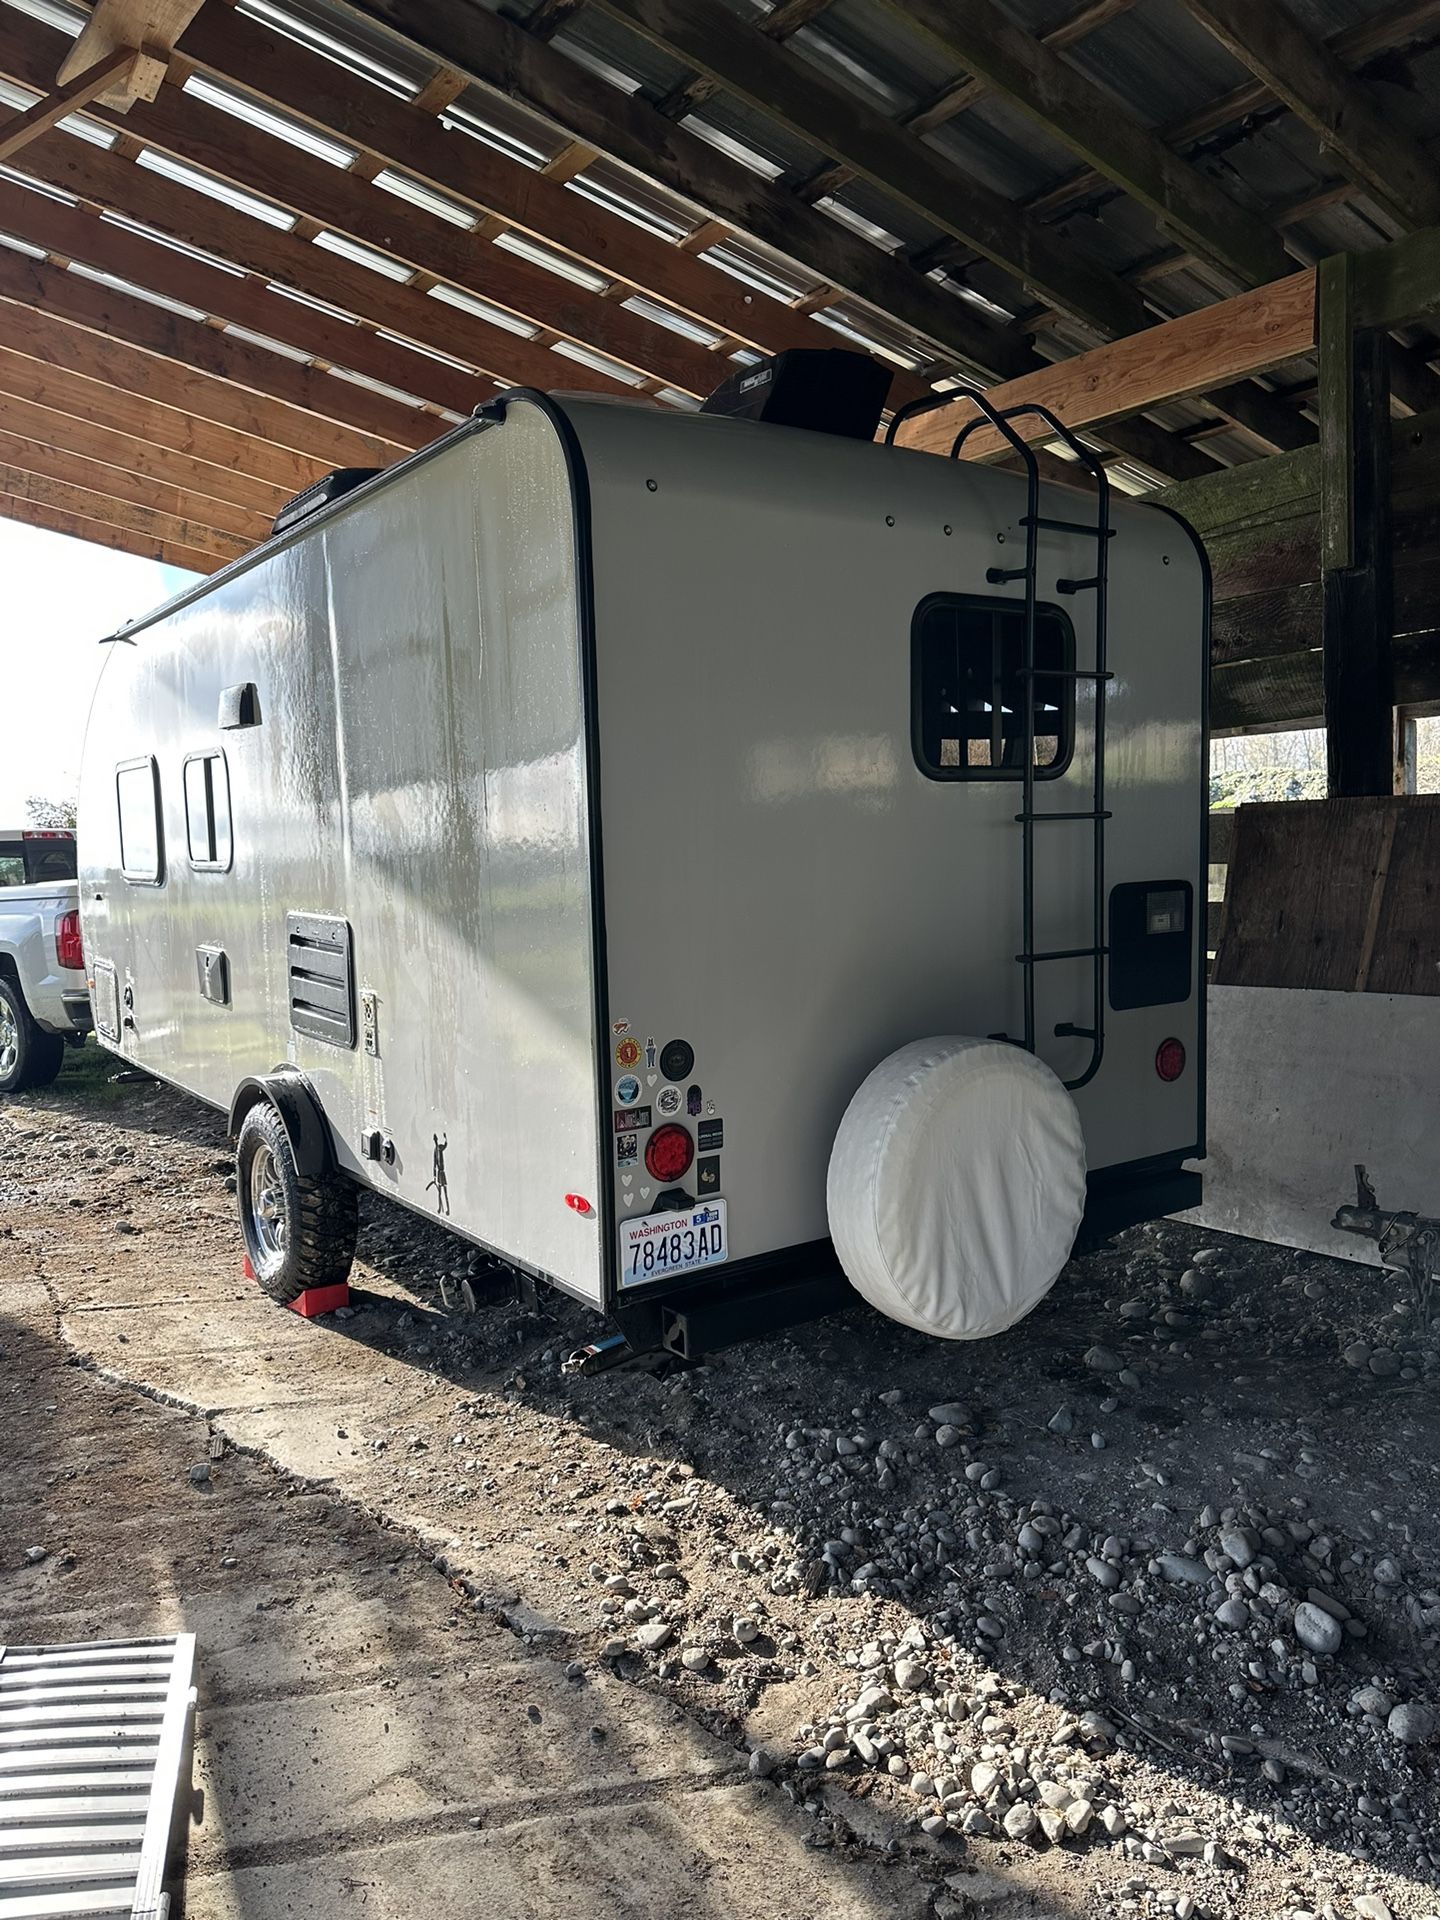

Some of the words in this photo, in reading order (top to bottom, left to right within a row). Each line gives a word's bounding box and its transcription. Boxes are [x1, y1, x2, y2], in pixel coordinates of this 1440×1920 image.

[629, 1219, 687, 1240] WASHINGTON
[629, 1224, 722, 1275] 78483AD
[651, 1264, 682, 1276] EVERGREEN
[685, 1259, 700, 1269] STATE
